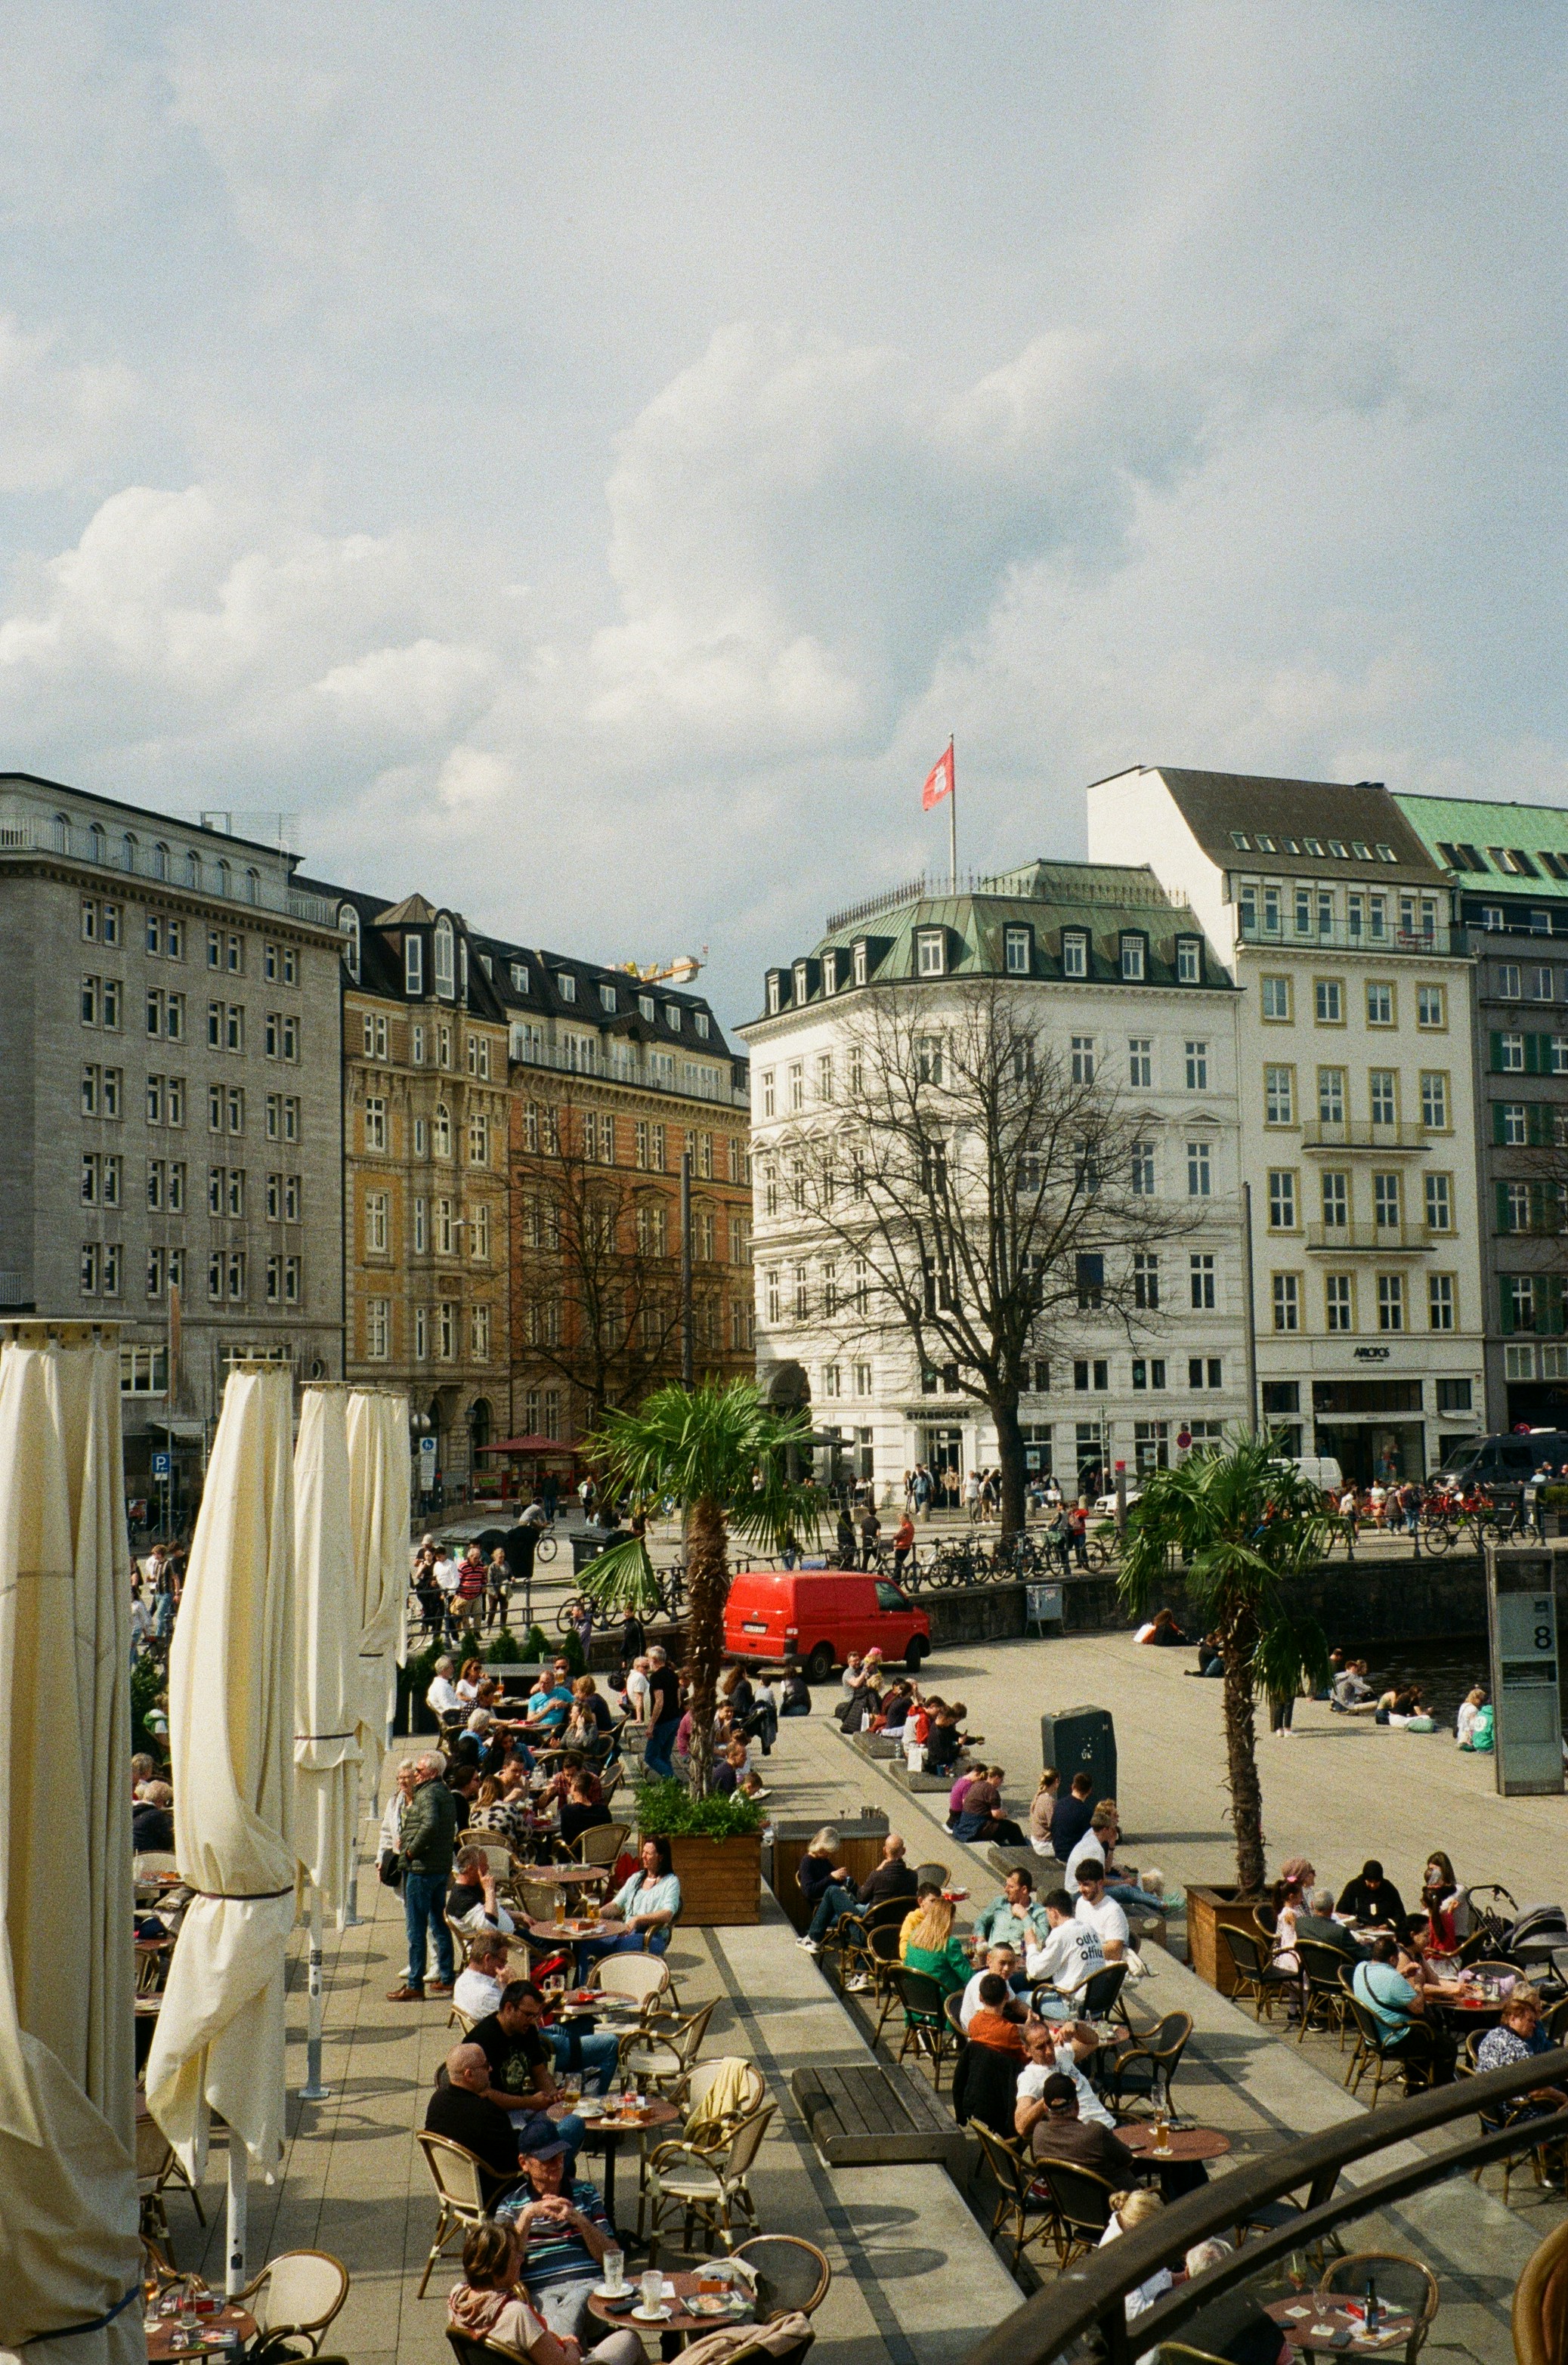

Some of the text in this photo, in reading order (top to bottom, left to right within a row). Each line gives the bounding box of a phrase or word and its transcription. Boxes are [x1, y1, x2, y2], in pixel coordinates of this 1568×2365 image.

[907, 1411, 970, 1419] STARBUCKS
[156, 1455, 166, 1470] P
[1535, 1625, 1551, 1649] 8
[1076, 1933, 1093, 1946] out
